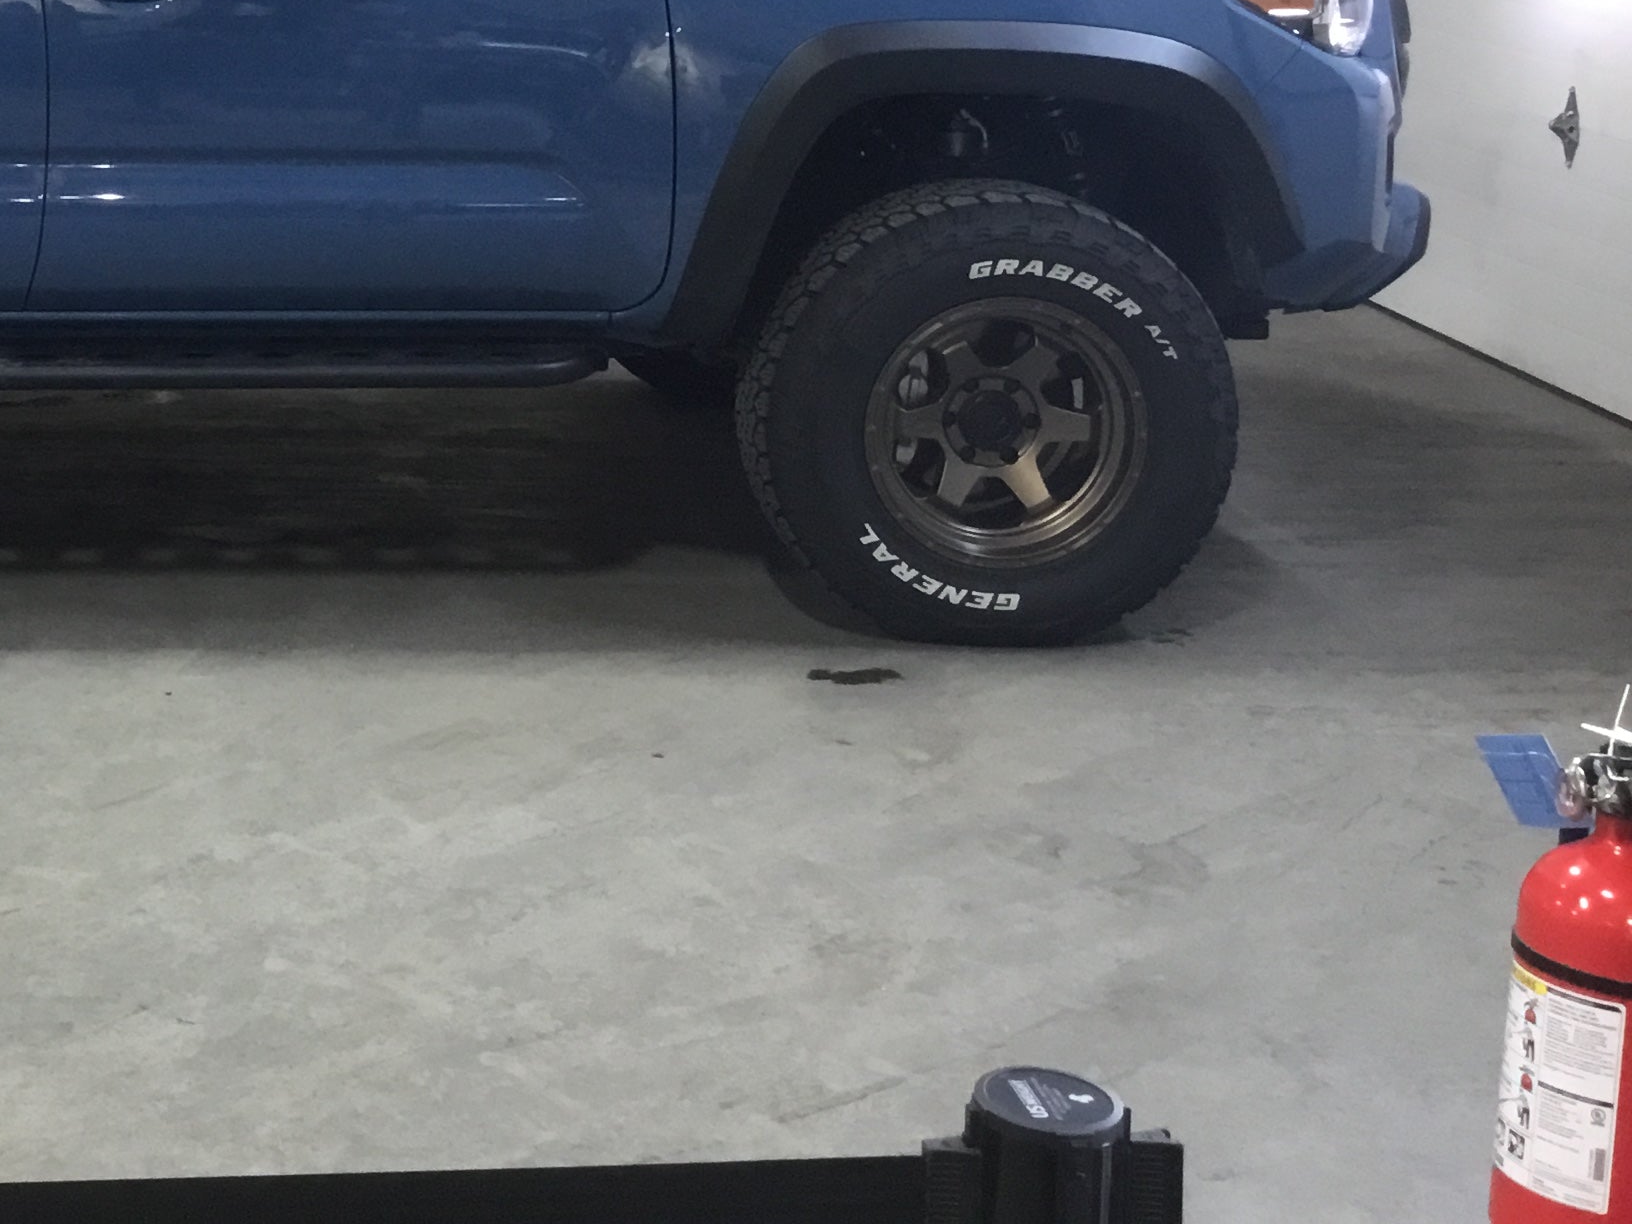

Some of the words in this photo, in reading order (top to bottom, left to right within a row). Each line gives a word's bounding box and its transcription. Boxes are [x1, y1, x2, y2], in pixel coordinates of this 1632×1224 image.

[968, 258, 1143, 319] GRABBER
[1144, 324, 1179, 360] A/T
[858, 522, 1022, 612] GENERAL
